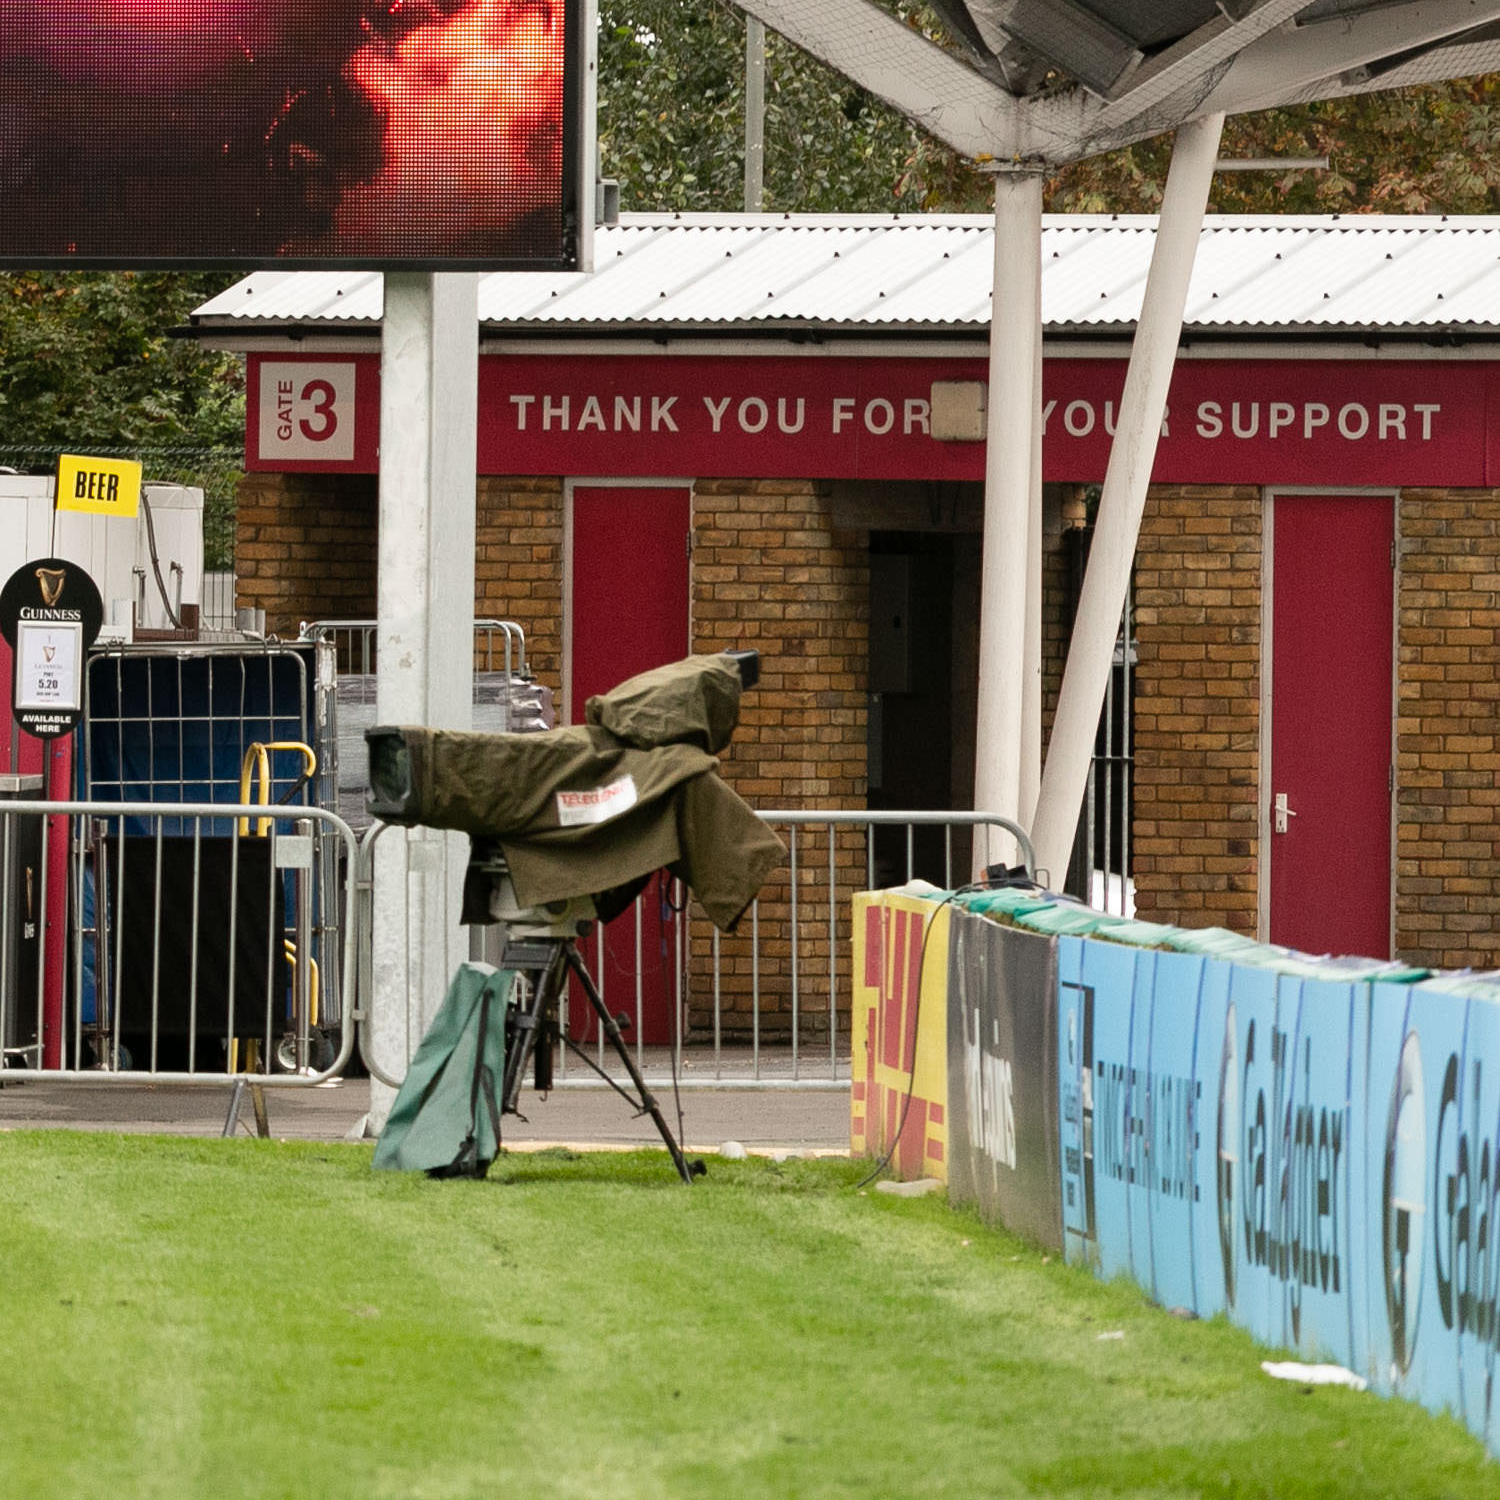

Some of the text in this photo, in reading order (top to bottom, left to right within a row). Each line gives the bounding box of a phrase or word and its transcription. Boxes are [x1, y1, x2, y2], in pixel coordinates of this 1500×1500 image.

[276, 378, 338, 442] GATE 3
[509, 395, 1442, 441] THANK YOU FOR YOU SUPPORT
[75, 470, 119, 503] BEER
[19, 606, 82, 622] GUINNESS
[38, 679, 59, 690] 5.20
[21, 714, 72, 725] AVAILABLE
[35, 723, 61, 734] HERE
